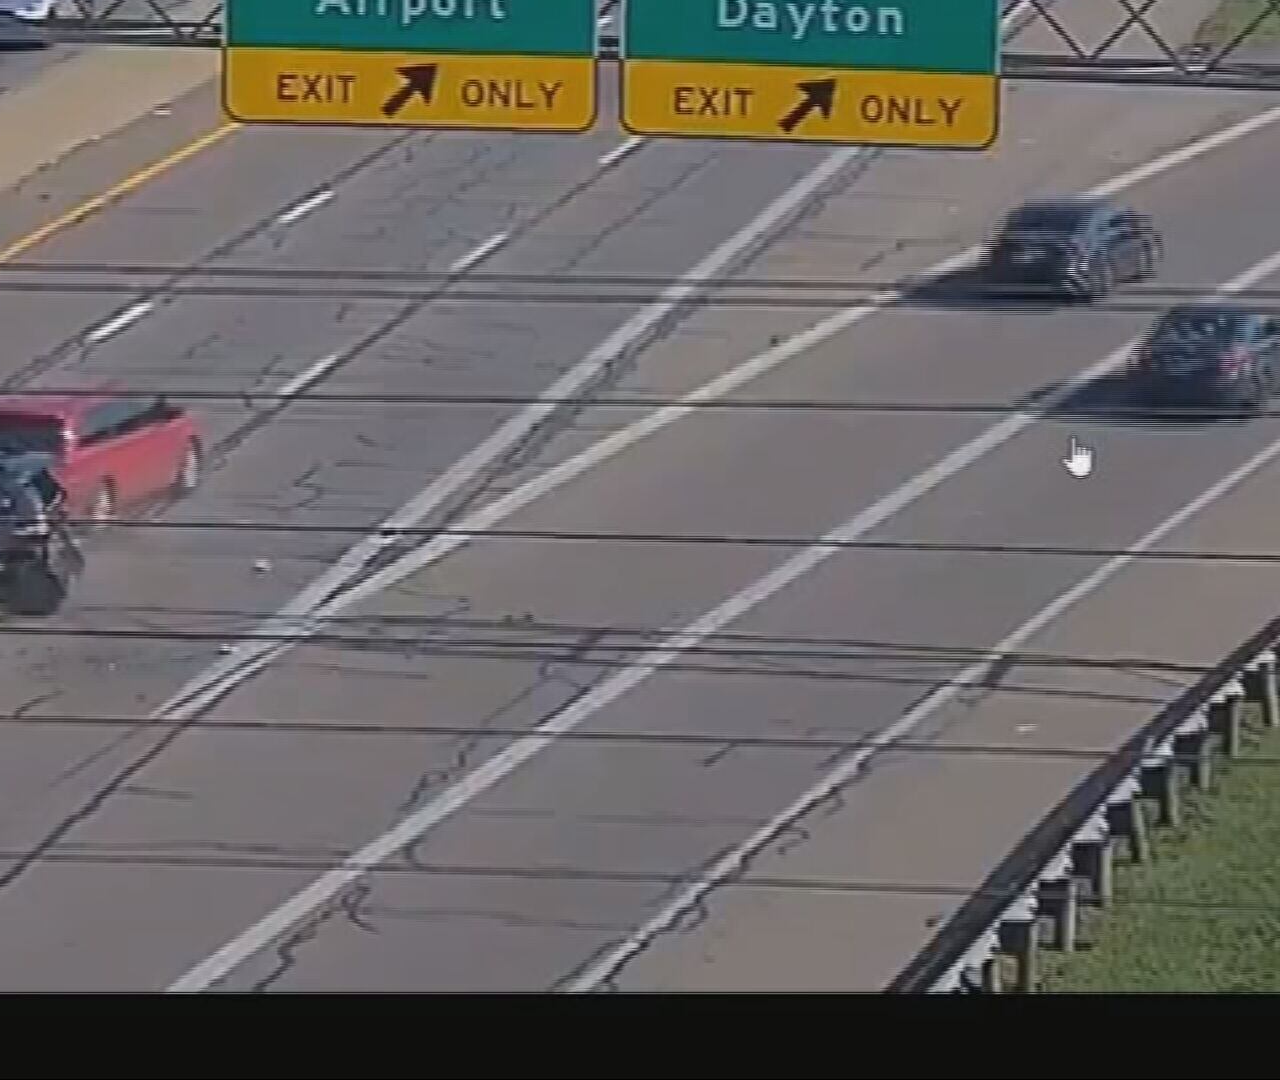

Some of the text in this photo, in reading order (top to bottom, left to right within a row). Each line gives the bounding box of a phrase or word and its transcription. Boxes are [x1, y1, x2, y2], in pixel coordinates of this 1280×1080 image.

[276, 73, 563, 110] EXIT ONLY
[674, 86, 964, 126] EXIT ONLY
